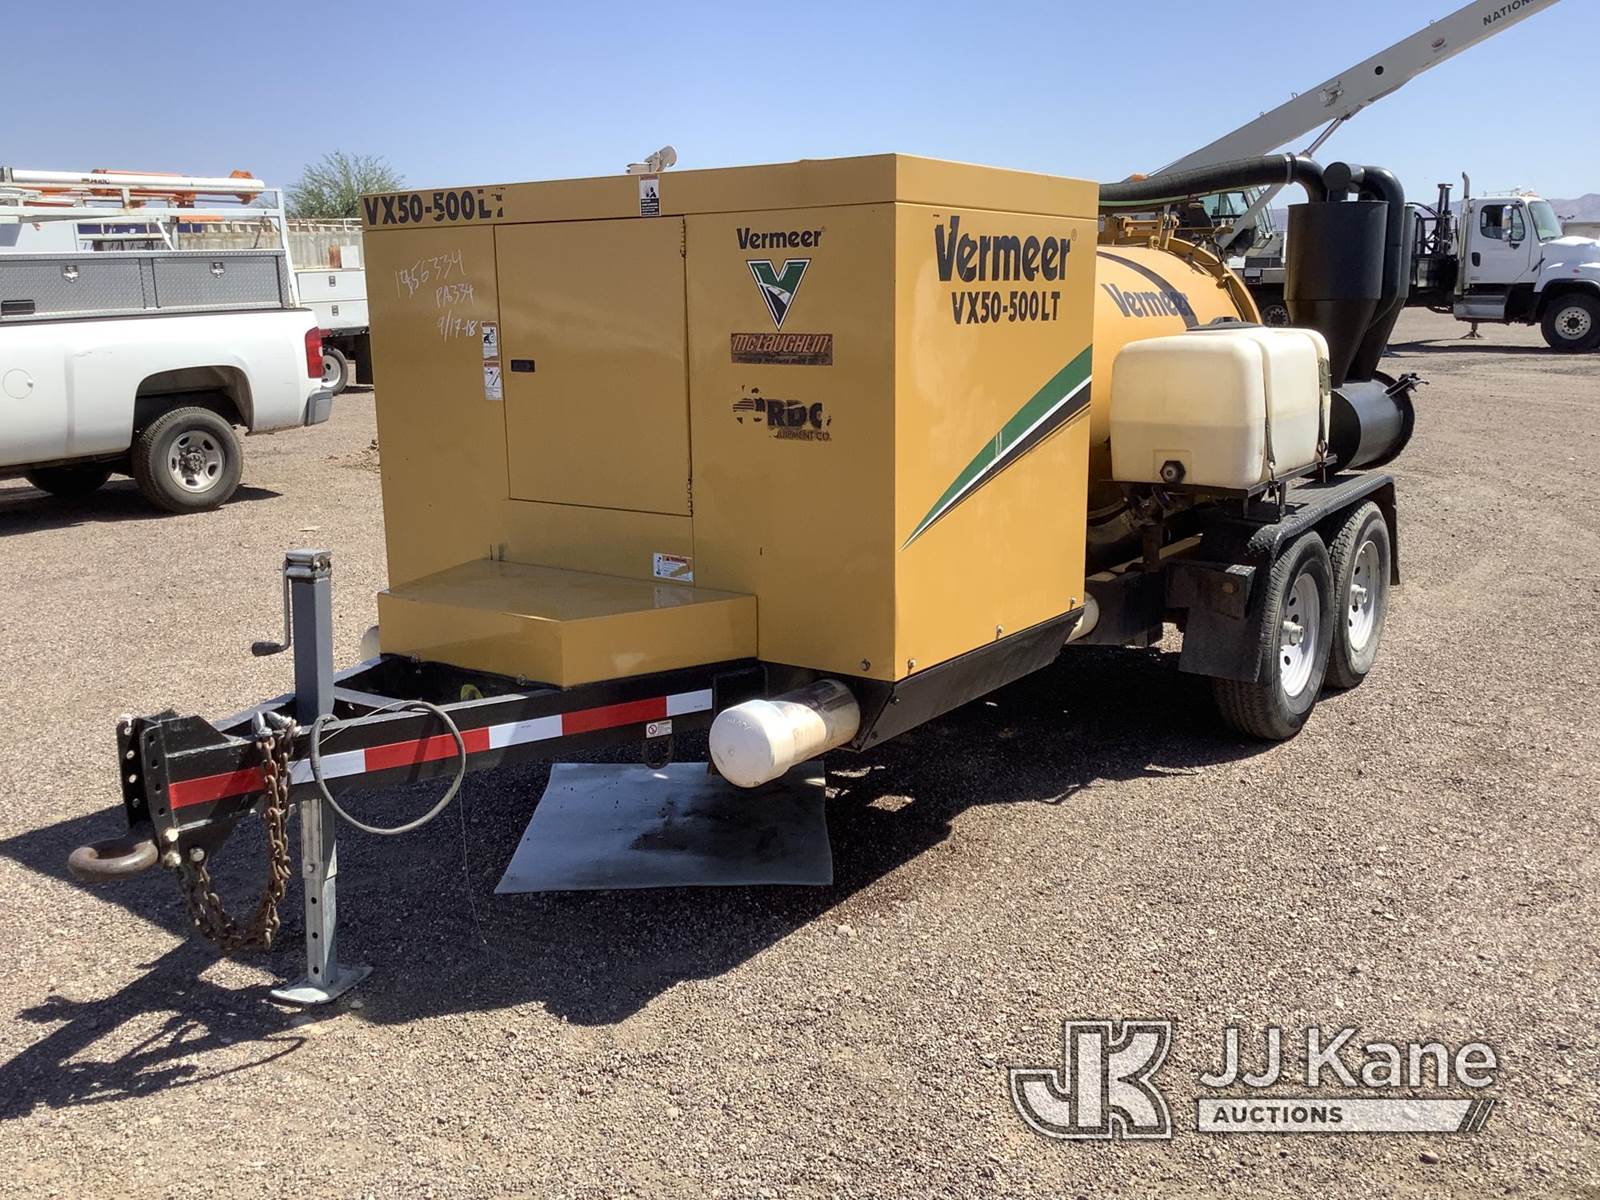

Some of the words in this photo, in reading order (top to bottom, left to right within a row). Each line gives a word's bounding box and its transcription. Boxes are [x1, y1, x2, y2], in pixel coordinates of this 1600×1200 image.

[1483, 0, 1534, 26] NATION
[736, 227, 822, 250] Vermeer
[934, 215, 1071, 283] Vermeer
[951, 290, 1060, 325] VX50-500LT
